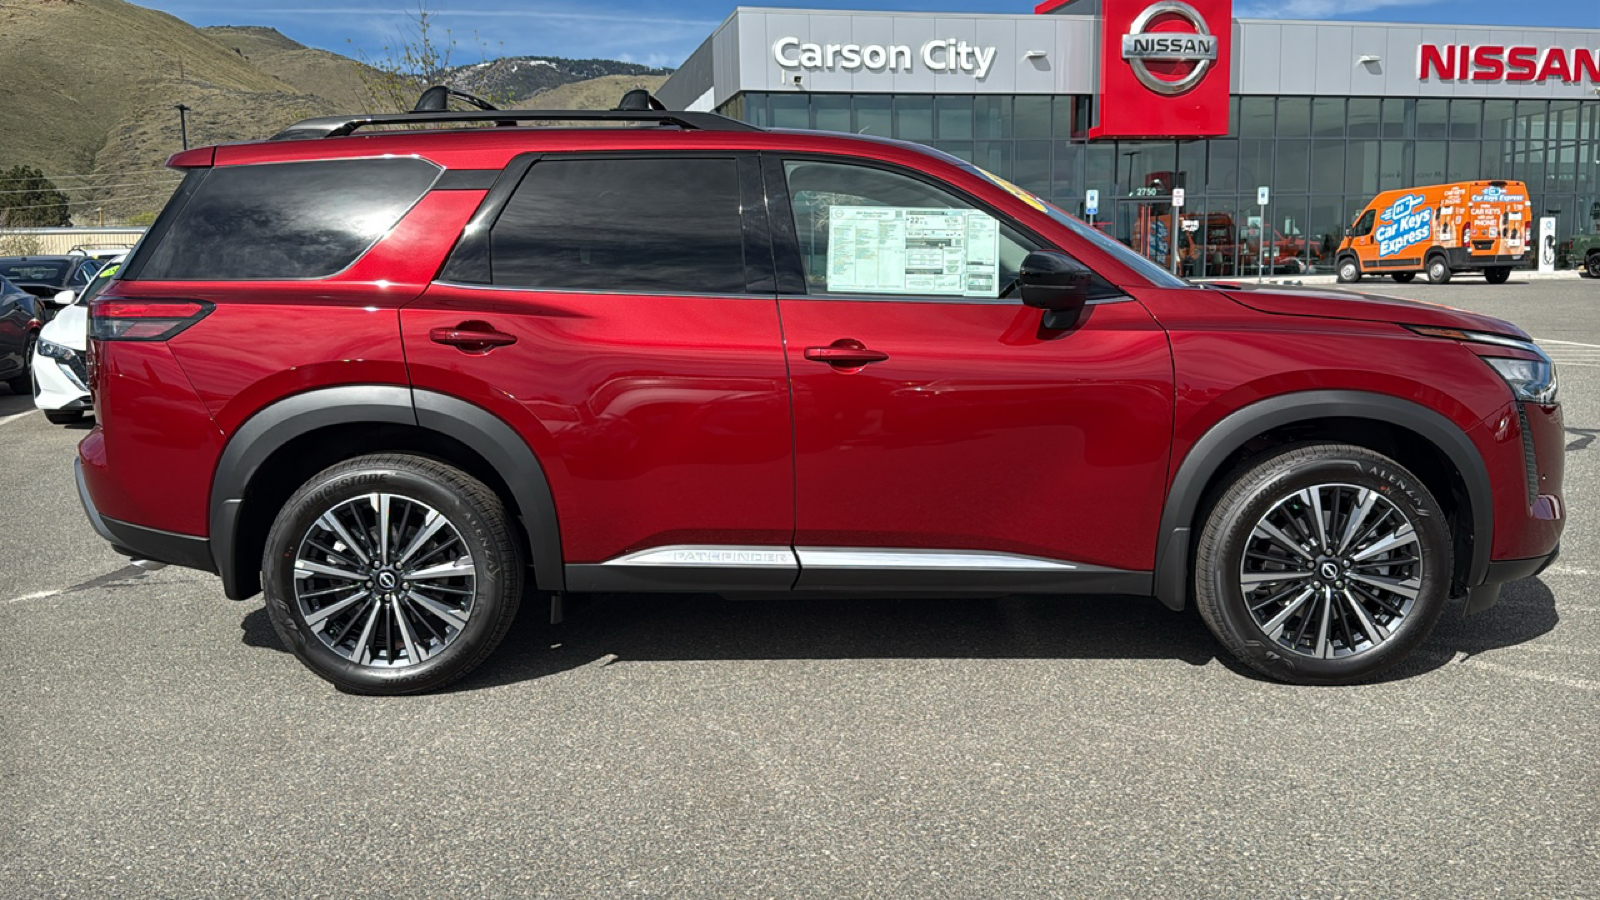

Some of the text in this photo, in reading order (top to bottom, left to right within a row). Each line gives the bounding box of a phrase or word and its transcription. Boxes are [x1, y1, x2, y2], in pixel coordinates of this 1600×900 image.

[773, 36, 996, 78] Carson City
[1133, 39, 1210, 53] NISSAN
[1418, 44, 1600, 82] NISSAN
[1136, 188, 1157, 196] 2750
[1472, 194, 1524, 202] Car Keys Express
[1376, 209, 1431, 242] Car Keys
[1380, 225, 1430, 256] Express
[1368, 465, 1423, 506] ALENZA
[461, 511, 497, 569] ALENZA
[673, 551, 788, 563] PATHFINDER
